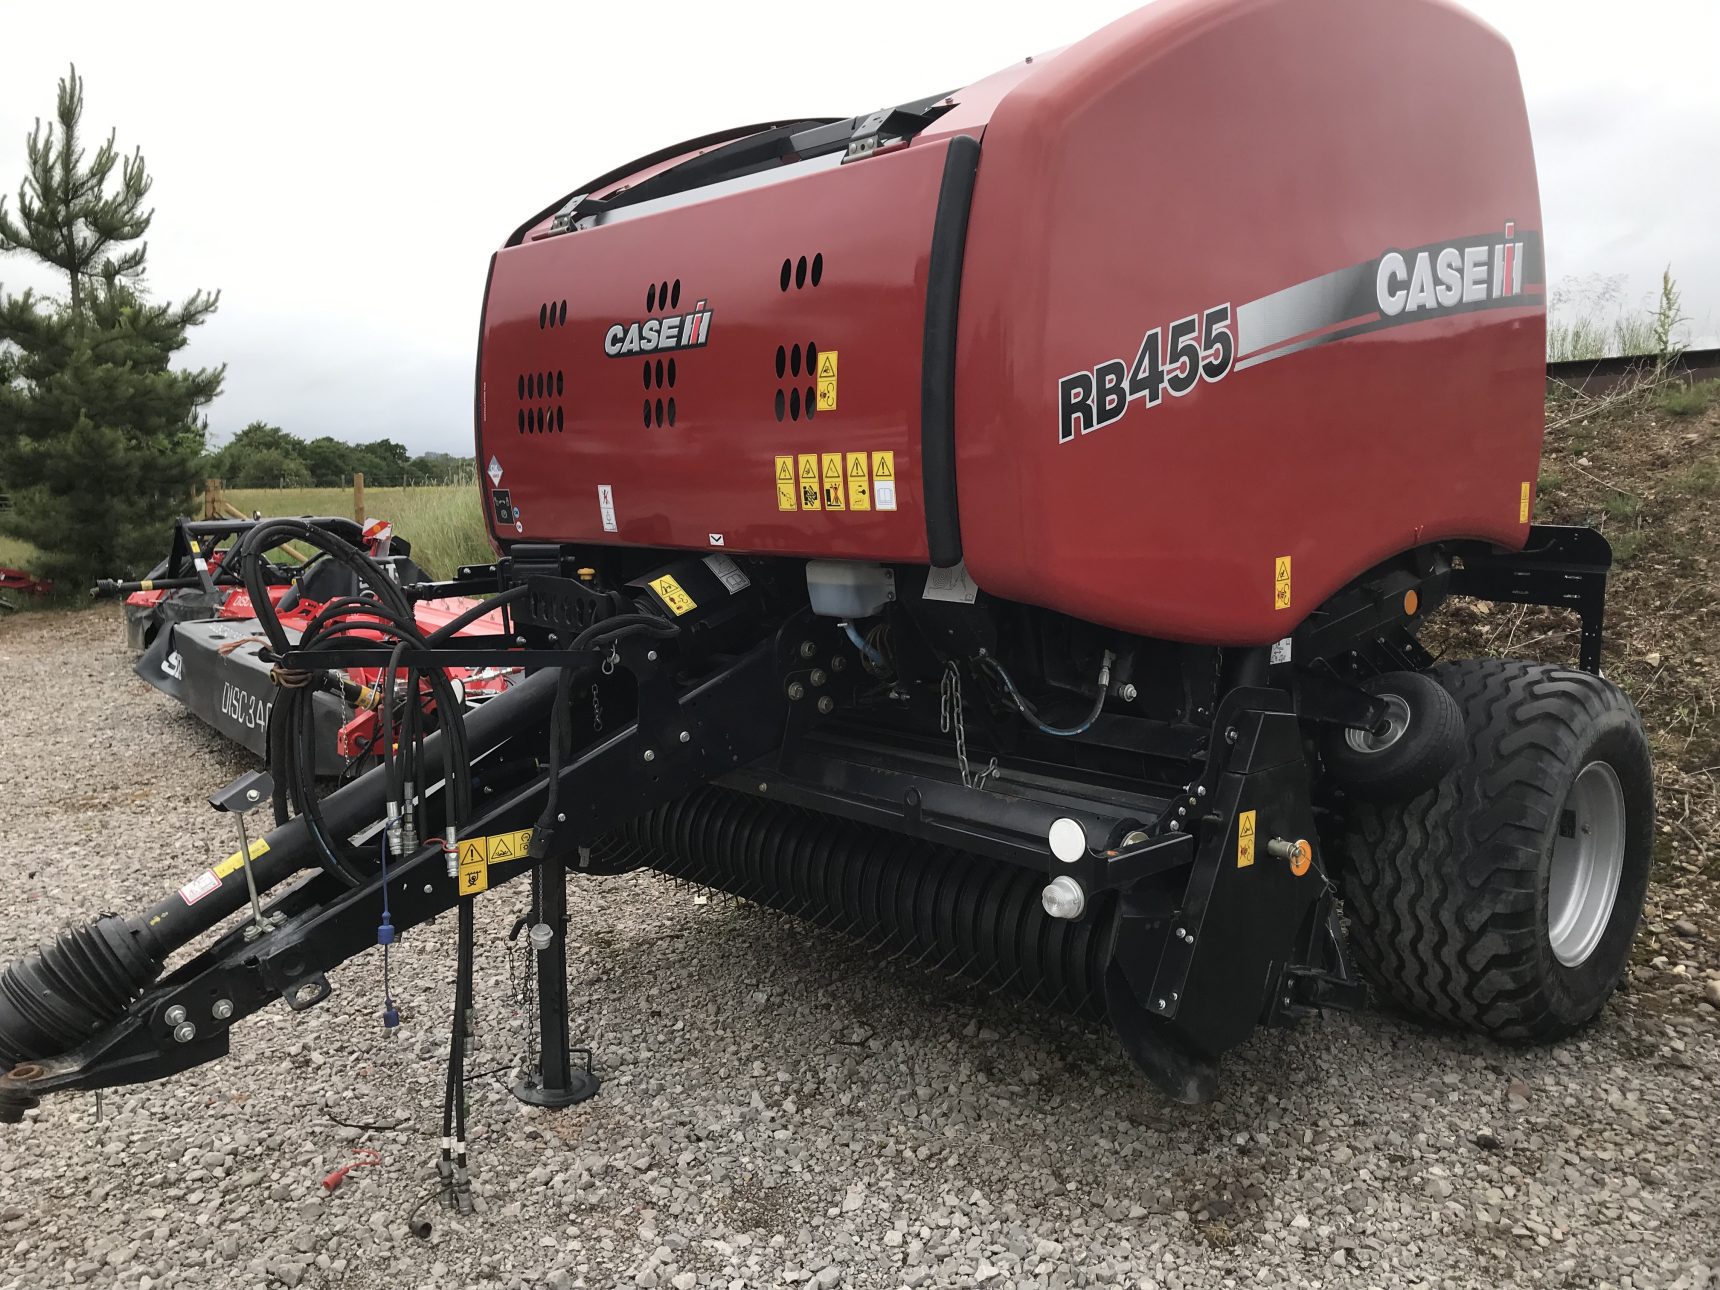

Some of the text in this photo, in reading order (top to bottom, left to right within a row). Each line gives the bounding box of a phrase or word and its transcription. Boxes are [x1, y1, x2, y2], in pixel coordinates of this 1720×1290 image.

[1376, 246, 1489, 316] CASE
[604, 316, 681, 355] CASE
[1059, 302, 1235, 444] RB455
